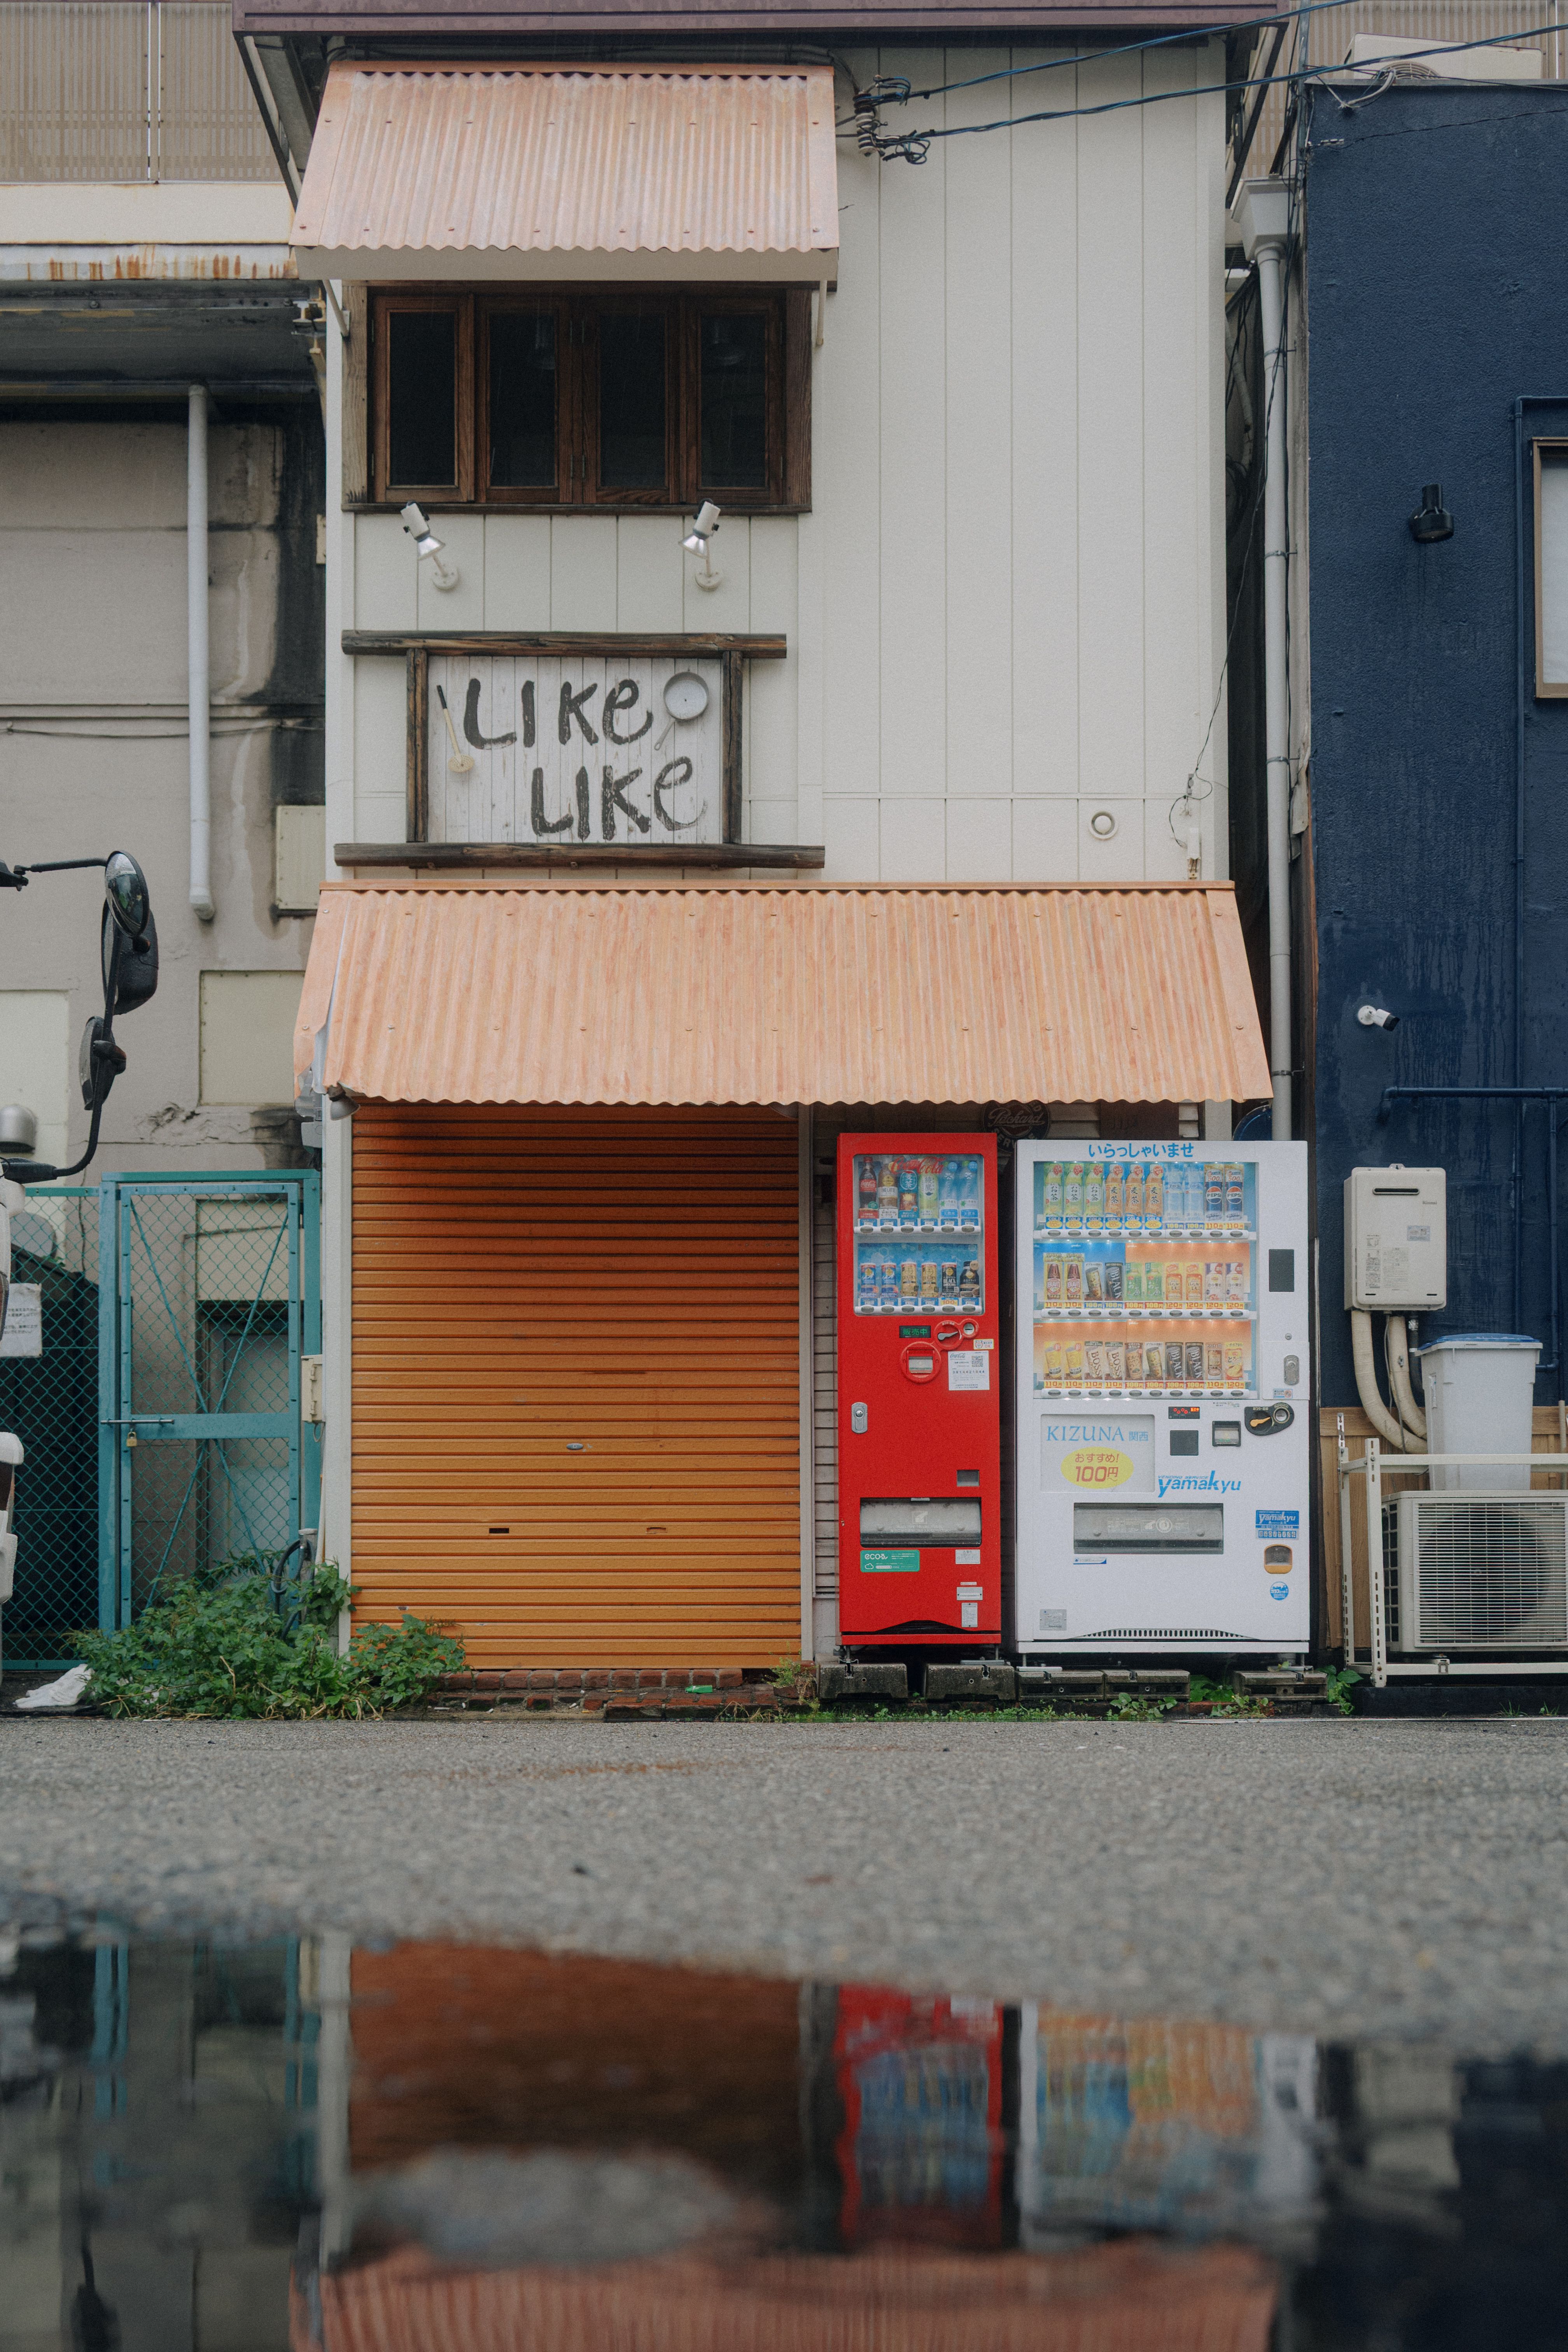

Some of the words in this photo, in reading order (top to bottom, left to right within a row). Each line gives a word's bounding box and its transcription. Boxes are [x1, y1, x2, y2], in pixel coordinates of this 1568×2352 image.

[1089, 1143, 1194, 1158] いらっしゃいませ
[905, 1173, 914, 1188] 麦茶
[925, 1176, 932, 1191] 綾鷹
[1051, 1186, 1058, 1201] お茶
[1071, 1186, 1078, 1201] お茶
[1091, 1186, 1098, 1201] お茶
[1111, 1186, 1119, 1204] 麦茶
[1130, 1186, 1139, 1204] 麦茶
[1150, 1186, 1159, 1204] 麦茶
[1110, 1268, 1122, 1299] BLACK
[1092, 1351, 1102, 1376] BOSS
[1112, 1352, 1122, 1376] BOSS
[1171, 1351, 1183, 1378] BLACK
[1190, 1351, 1202, 1378] BLACK
[1046, 1426, 1125, 1441] KIZUNA
[1129, 1431, 1148, 1441] 関西
[1158, 1470, 1241, 1498] yamakyu
[1259, 1511, 1296, 1524] yamakyu
